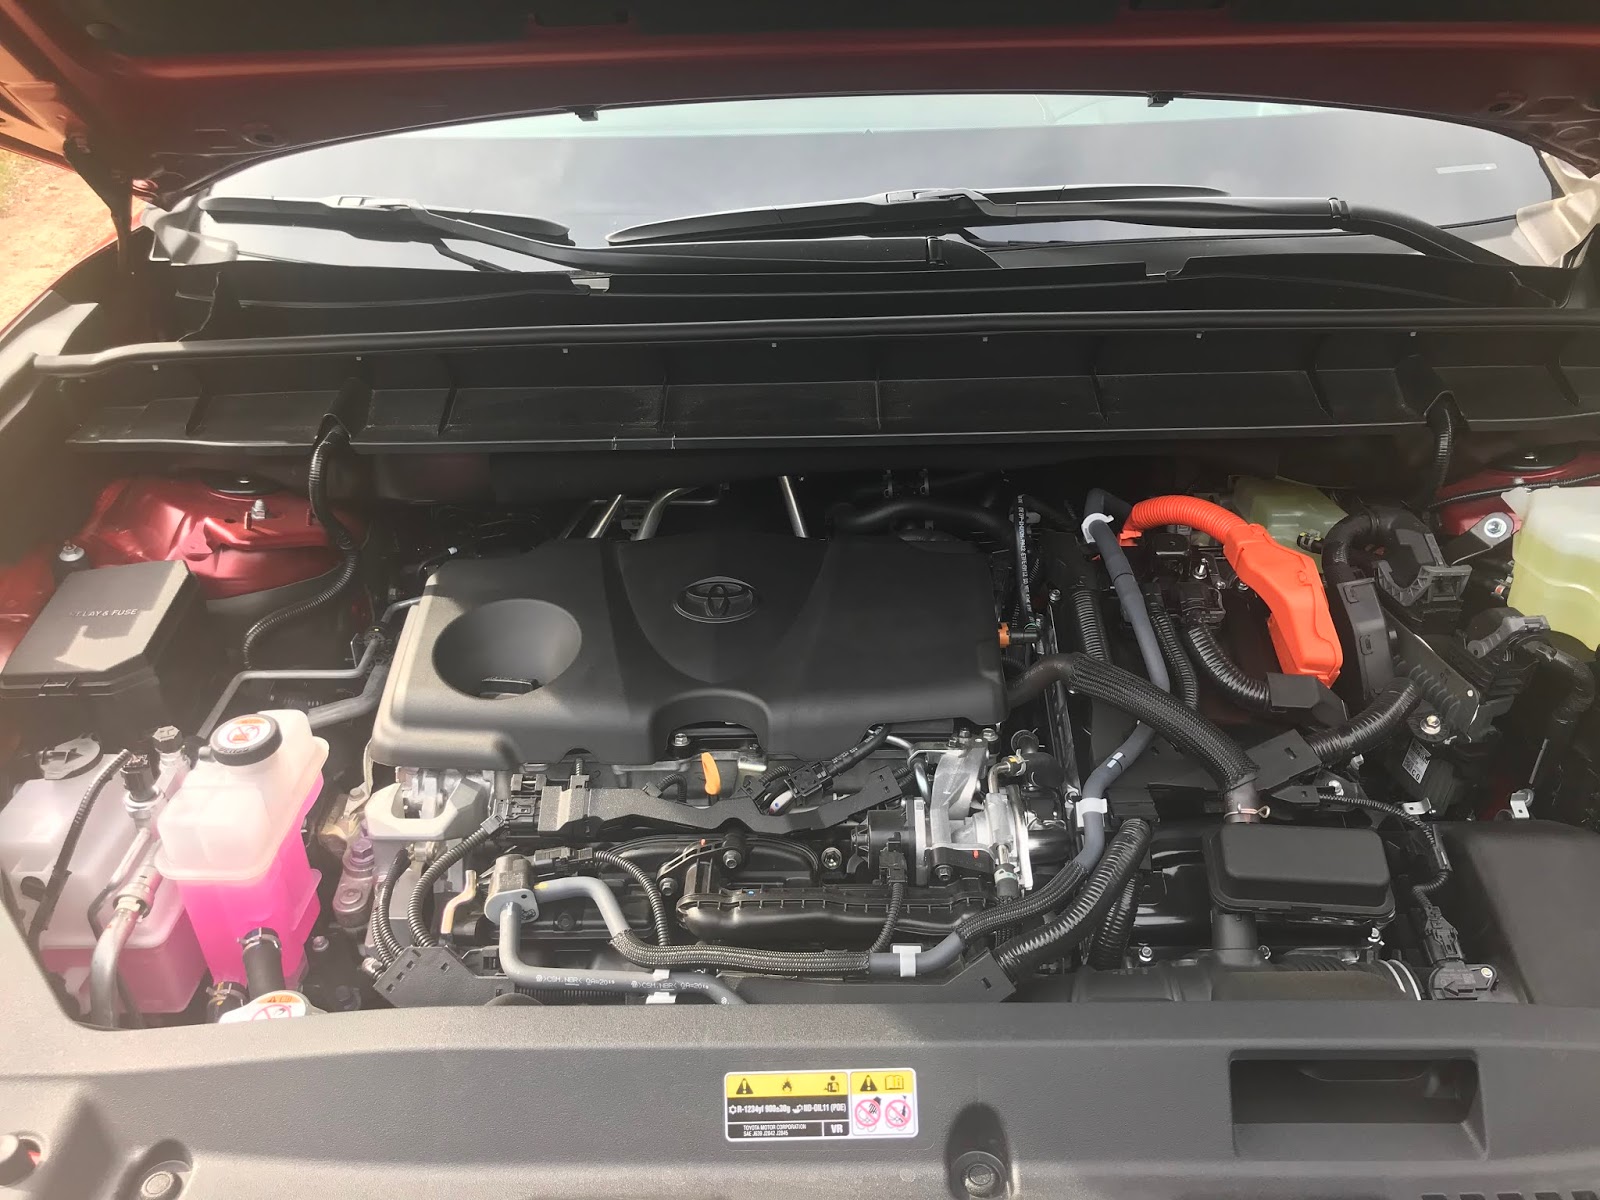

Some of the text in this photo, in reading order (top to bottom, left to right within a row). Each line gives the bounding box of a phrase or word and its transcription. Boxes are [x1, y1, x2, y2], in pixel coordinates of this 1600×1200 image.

[111, 608, 138, 616] FUSE
[776, 1123, 807, 1131] CORPORATION
[830, 1123, 844, 1134] VR
